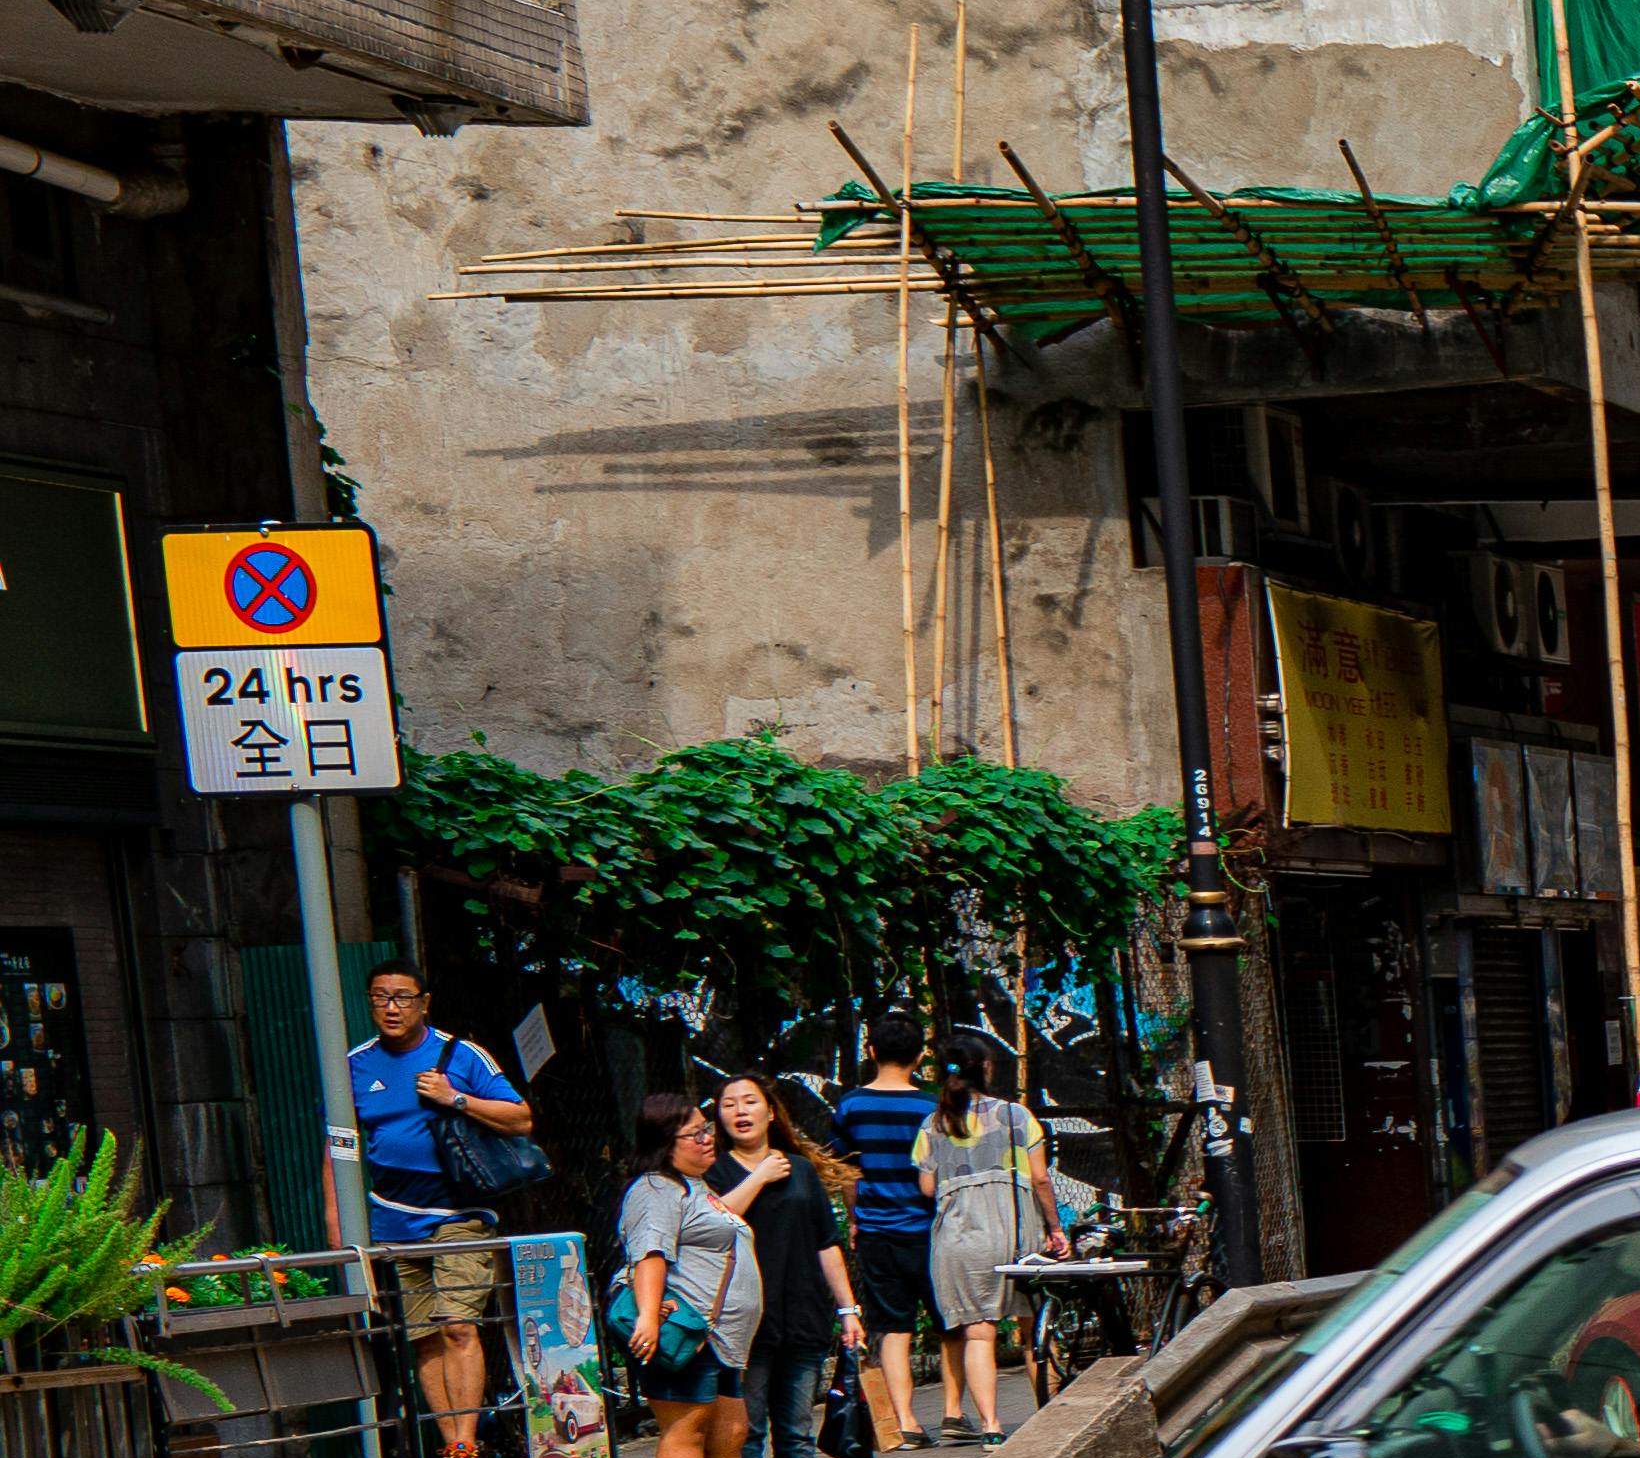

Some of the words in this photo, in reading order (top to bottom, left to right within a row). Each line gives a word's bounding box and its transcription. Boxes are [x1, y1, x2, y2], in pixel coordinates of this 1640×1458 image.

[203, 667, 271, 706] 24
[285, 666, 363, 704] hrs
[230, 718, 358, 780] 全日
[1193, 769, 1212, 838] 26914
